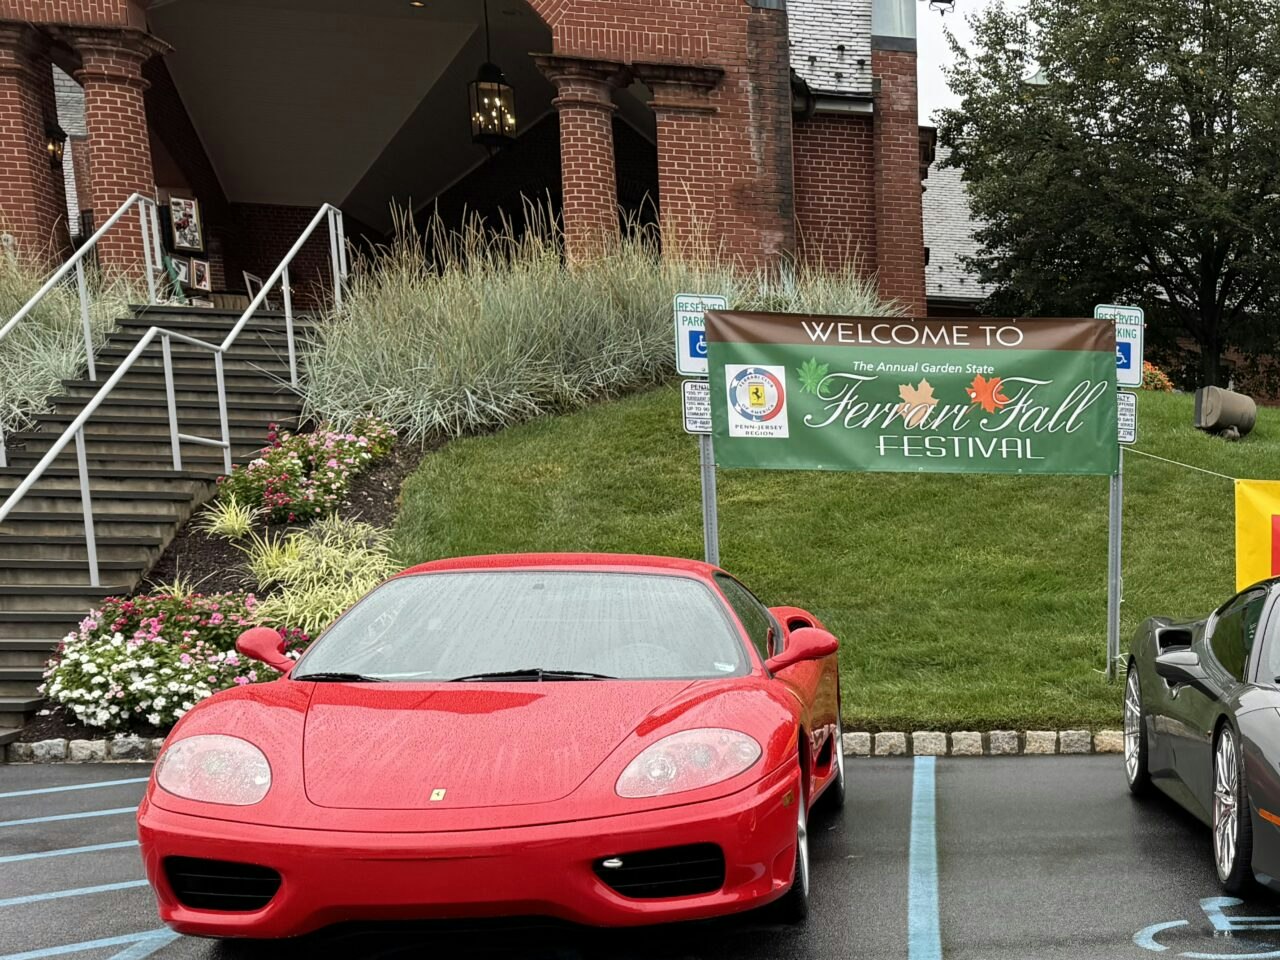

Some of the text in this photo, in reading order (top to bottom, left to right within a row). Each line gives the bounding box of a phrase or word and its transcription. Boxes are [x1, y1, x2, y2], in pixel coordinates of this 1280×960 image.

[678, 302, 723, 312] RESERVED
[682, 315, 705, 326] PARK
[801, 321, 1024, 346] WELCOME TO
[1117, 328, 1137, 339] KING
[853, 361, 995, 374] The Annual Garden State
[739, 375, 760, 388] FERRARI
[803, 372, 1108, 433] Ferrari Fall
[750, 404, 774, 415] AMERICA
[875, 435, 1045, 459] FESTIVAL
